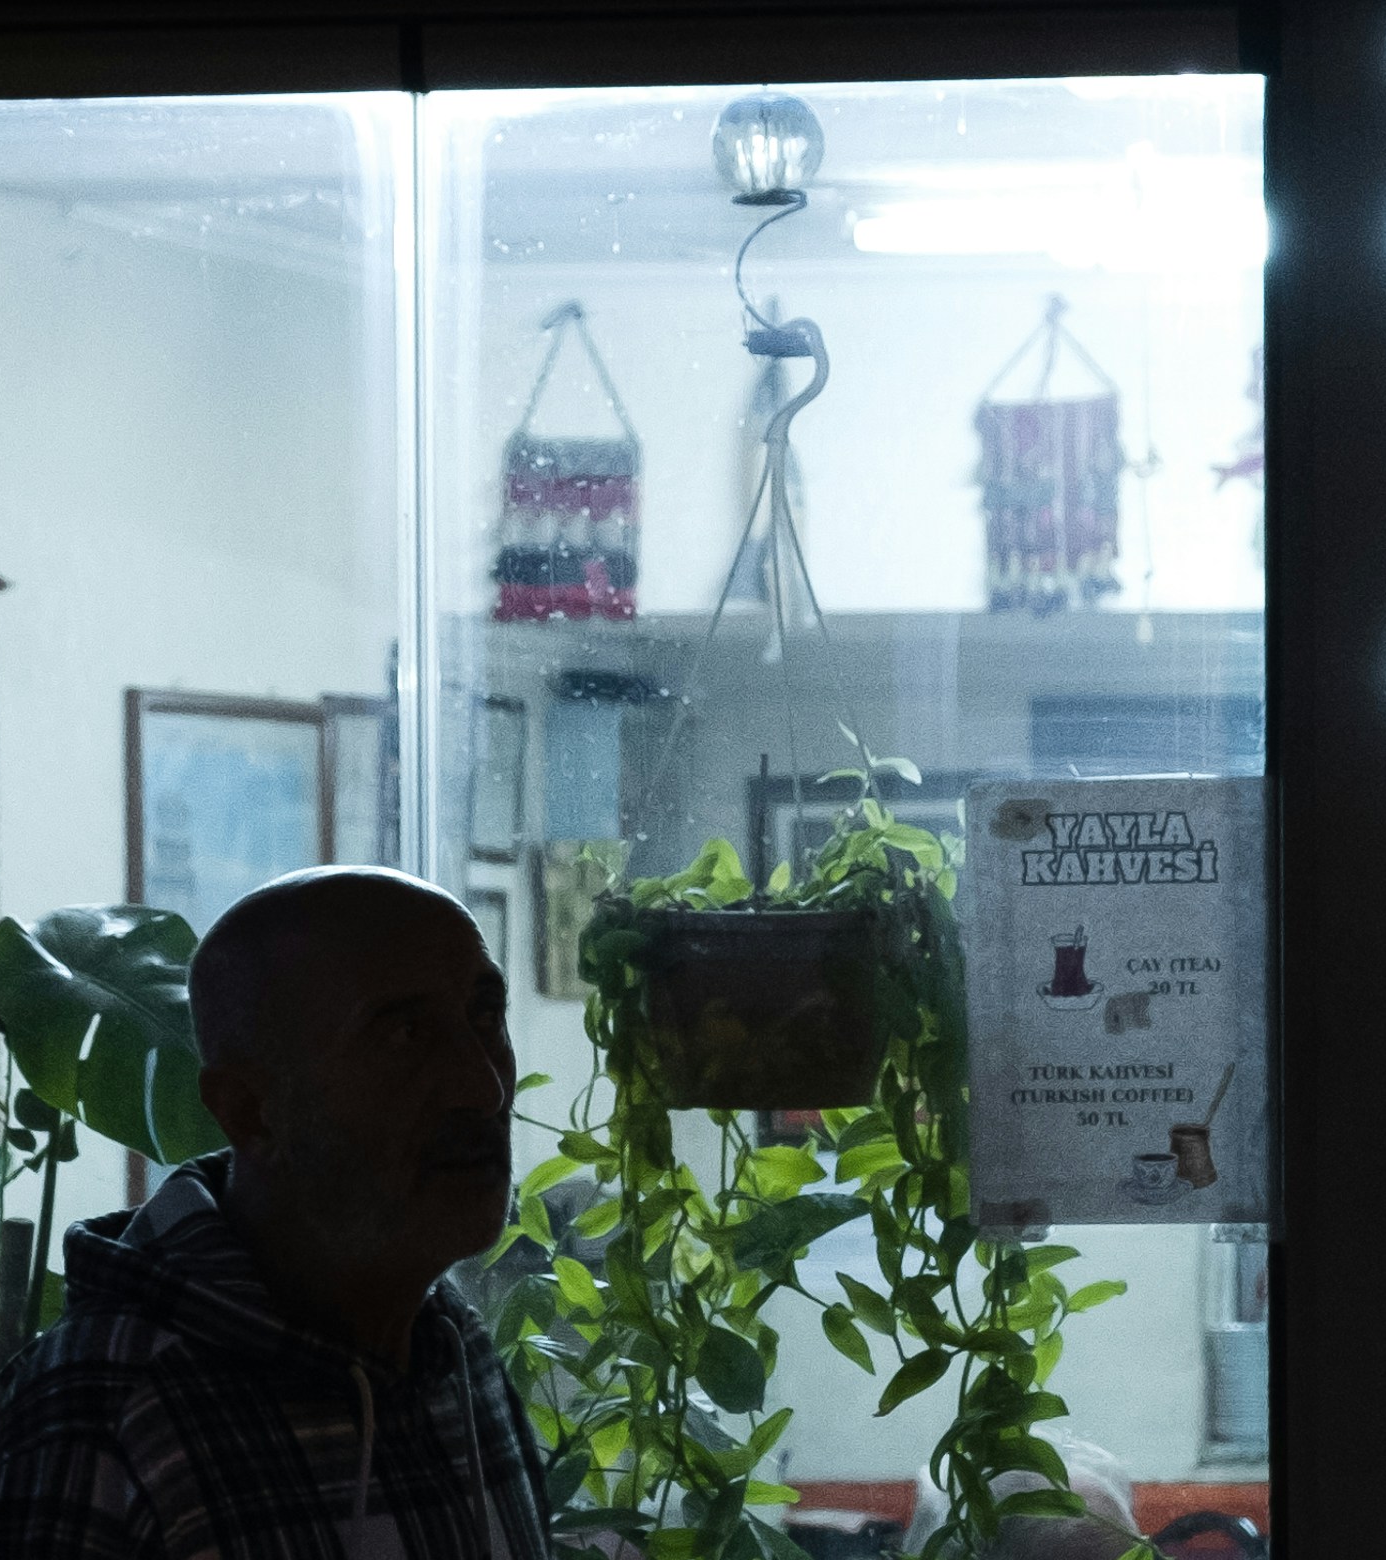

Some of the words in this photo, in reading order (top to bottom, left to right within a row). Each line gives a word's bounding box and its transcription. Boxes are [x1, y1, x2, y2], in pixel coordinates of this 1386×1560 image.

[1045, 811, 1195, 850] YAYLA
[1021, 840, 1219, 886] KAHVESİ
[1126, 957, 1162, 975] ÇAY
[1169, 957, 1222, 974] (TEA)
[1148, 980, 1171, 996] 20
[1176, 980, 1201, 996] TL
[1028, 1063, 1084, 1081] TÜRK
[1088, 1062, 1175, 1080] KAHVESİ
[1010, 1089, 1106, 1106] (TURKISH
[1110, 1088, 1195, 1105] COFFEE)
[1103, 1111, 1130, 1127] TL
